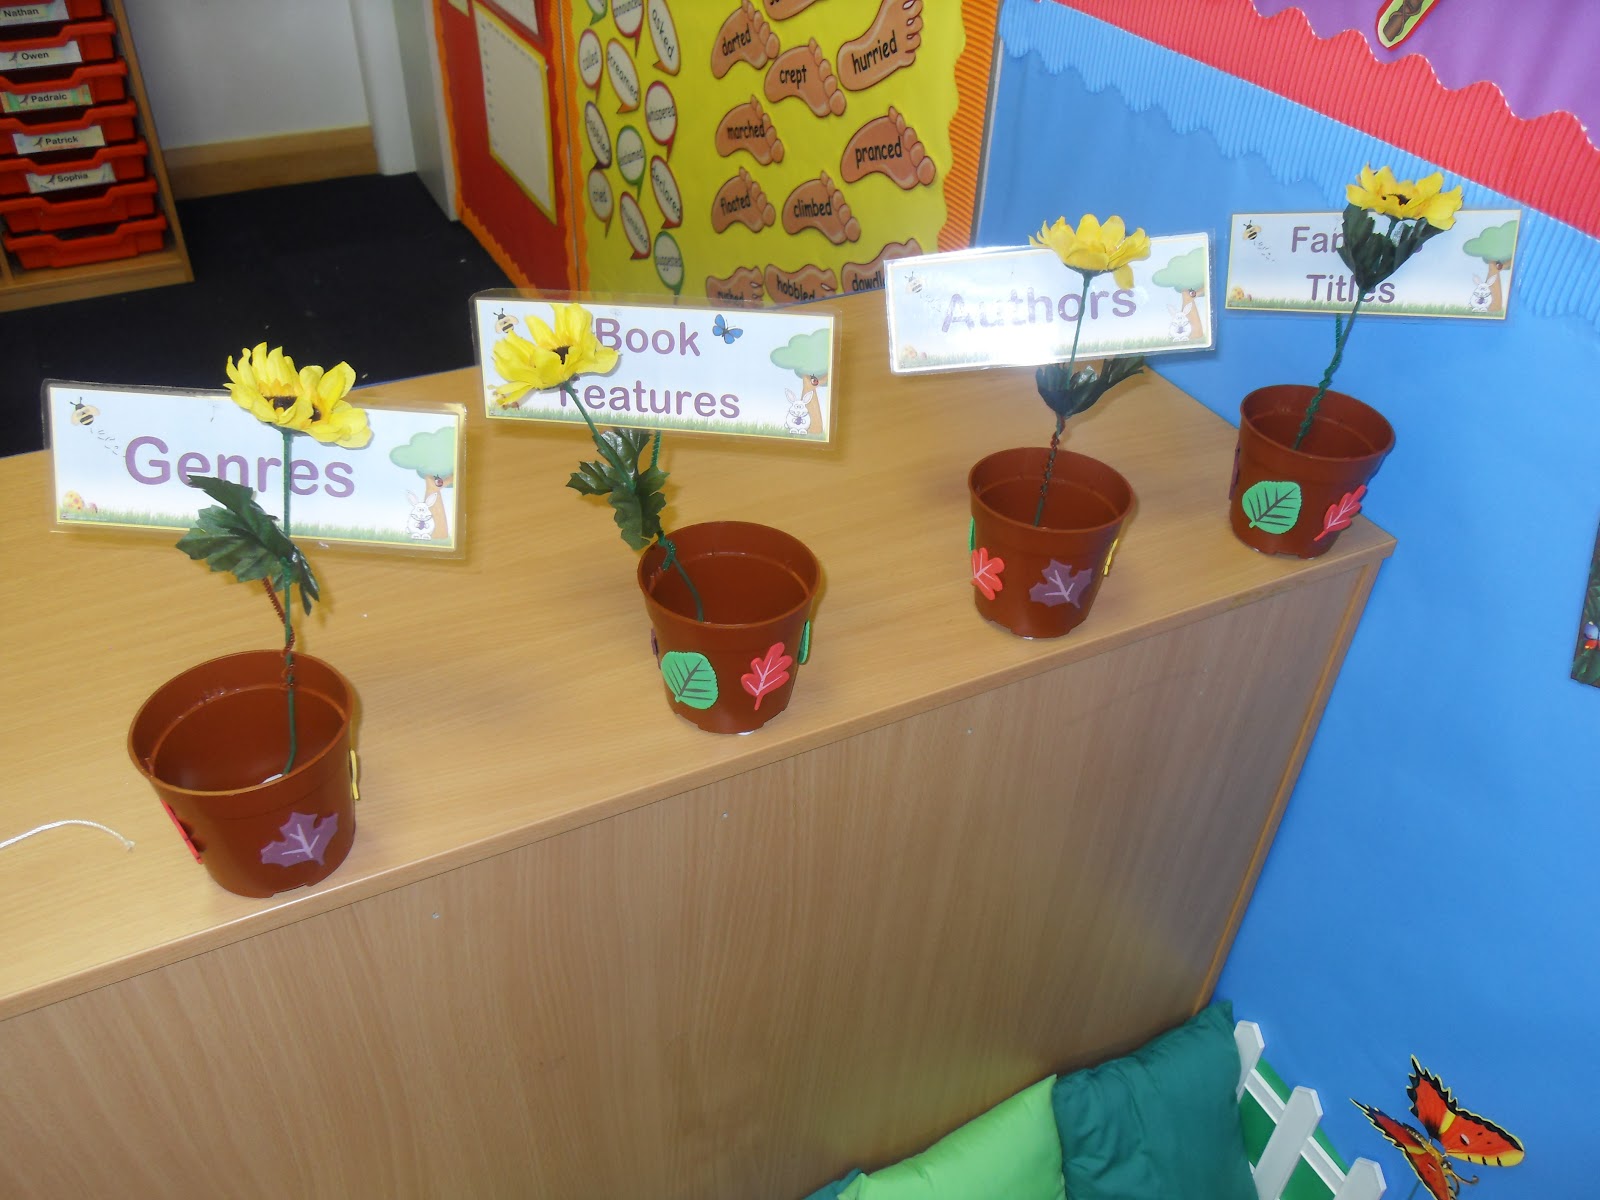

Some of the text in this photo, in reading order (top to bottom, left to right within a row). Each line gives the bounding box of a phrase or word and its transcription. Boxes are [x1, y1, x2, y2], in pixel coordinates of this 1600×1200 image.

[3, 7, 40, 17] Nathan
[652, 8, 675, 60] asked
[721, 23, 751, 56] darted
[21, 51, 49, 61] Owen
[852, 30, 898, 75] hurried
[779, 65, 807, 90] crept
[30, 92, 67, 103] Padraic
[45, 135, 78, 145] Patrick
[727, 121, 765, 140] marched
[855, 136, 902, 168] pranced
[57, 172, 88, 183] Sophia
[720, 193, 751, 216] floated
[793, 198, 832, 219] climbed
[776, 274, 815, 300] hobbled
[852, 270, 885, 291] dawdl
[942, 286, 1137, 332] Authors
[595, 318, 701, 356] Book
[125, 435, 355, 498] Genres
